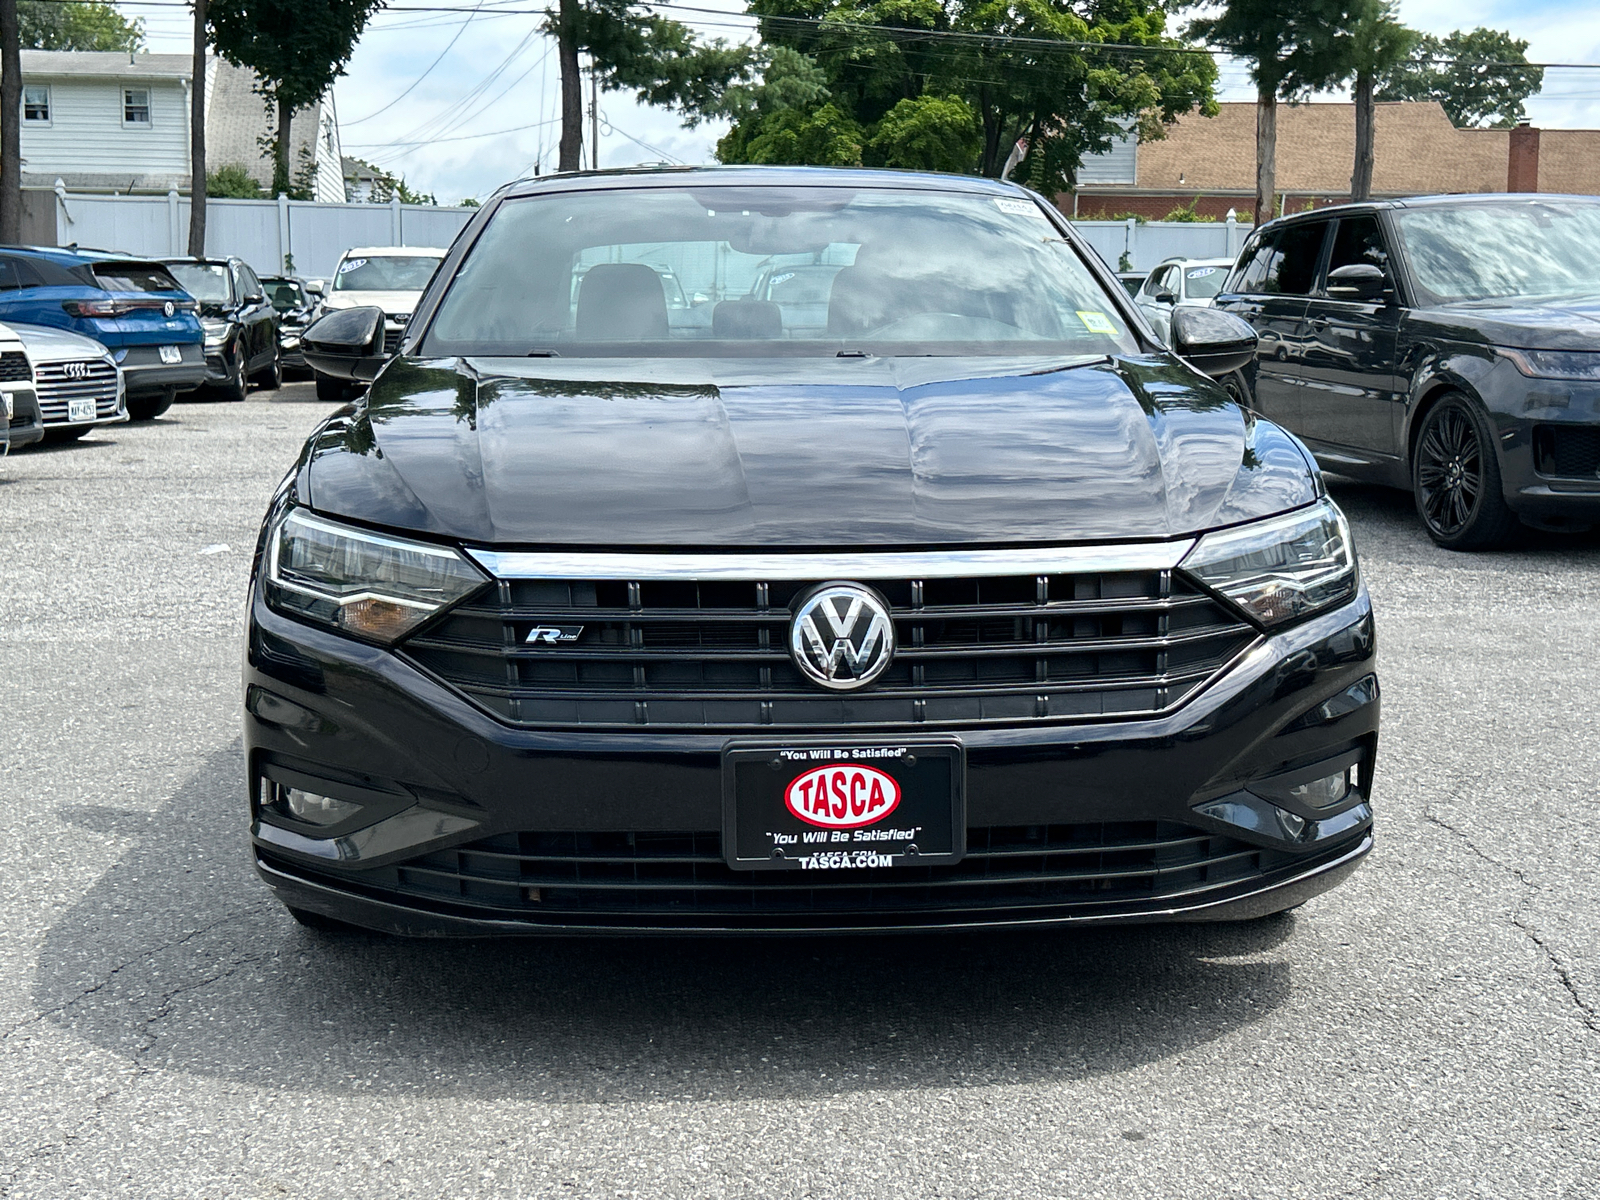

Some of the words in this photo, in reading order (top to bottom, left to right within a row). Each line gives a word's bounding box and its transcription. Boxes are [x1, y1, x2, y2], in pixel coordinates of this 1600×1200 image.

[525, 628, 561, 644] R
[780, 750, 807, 760] “You
[809, 749, 831, 760] Will
[834, 749, 849, 759] Be
[852, 748, 907, 759] Satisfied”
[798, 771, 886, 819] TASCA
[803, 831, 828, 843] Will
[830, 831, 850, 842] Be
[799, 855, 892, 869] TASCA.COM
